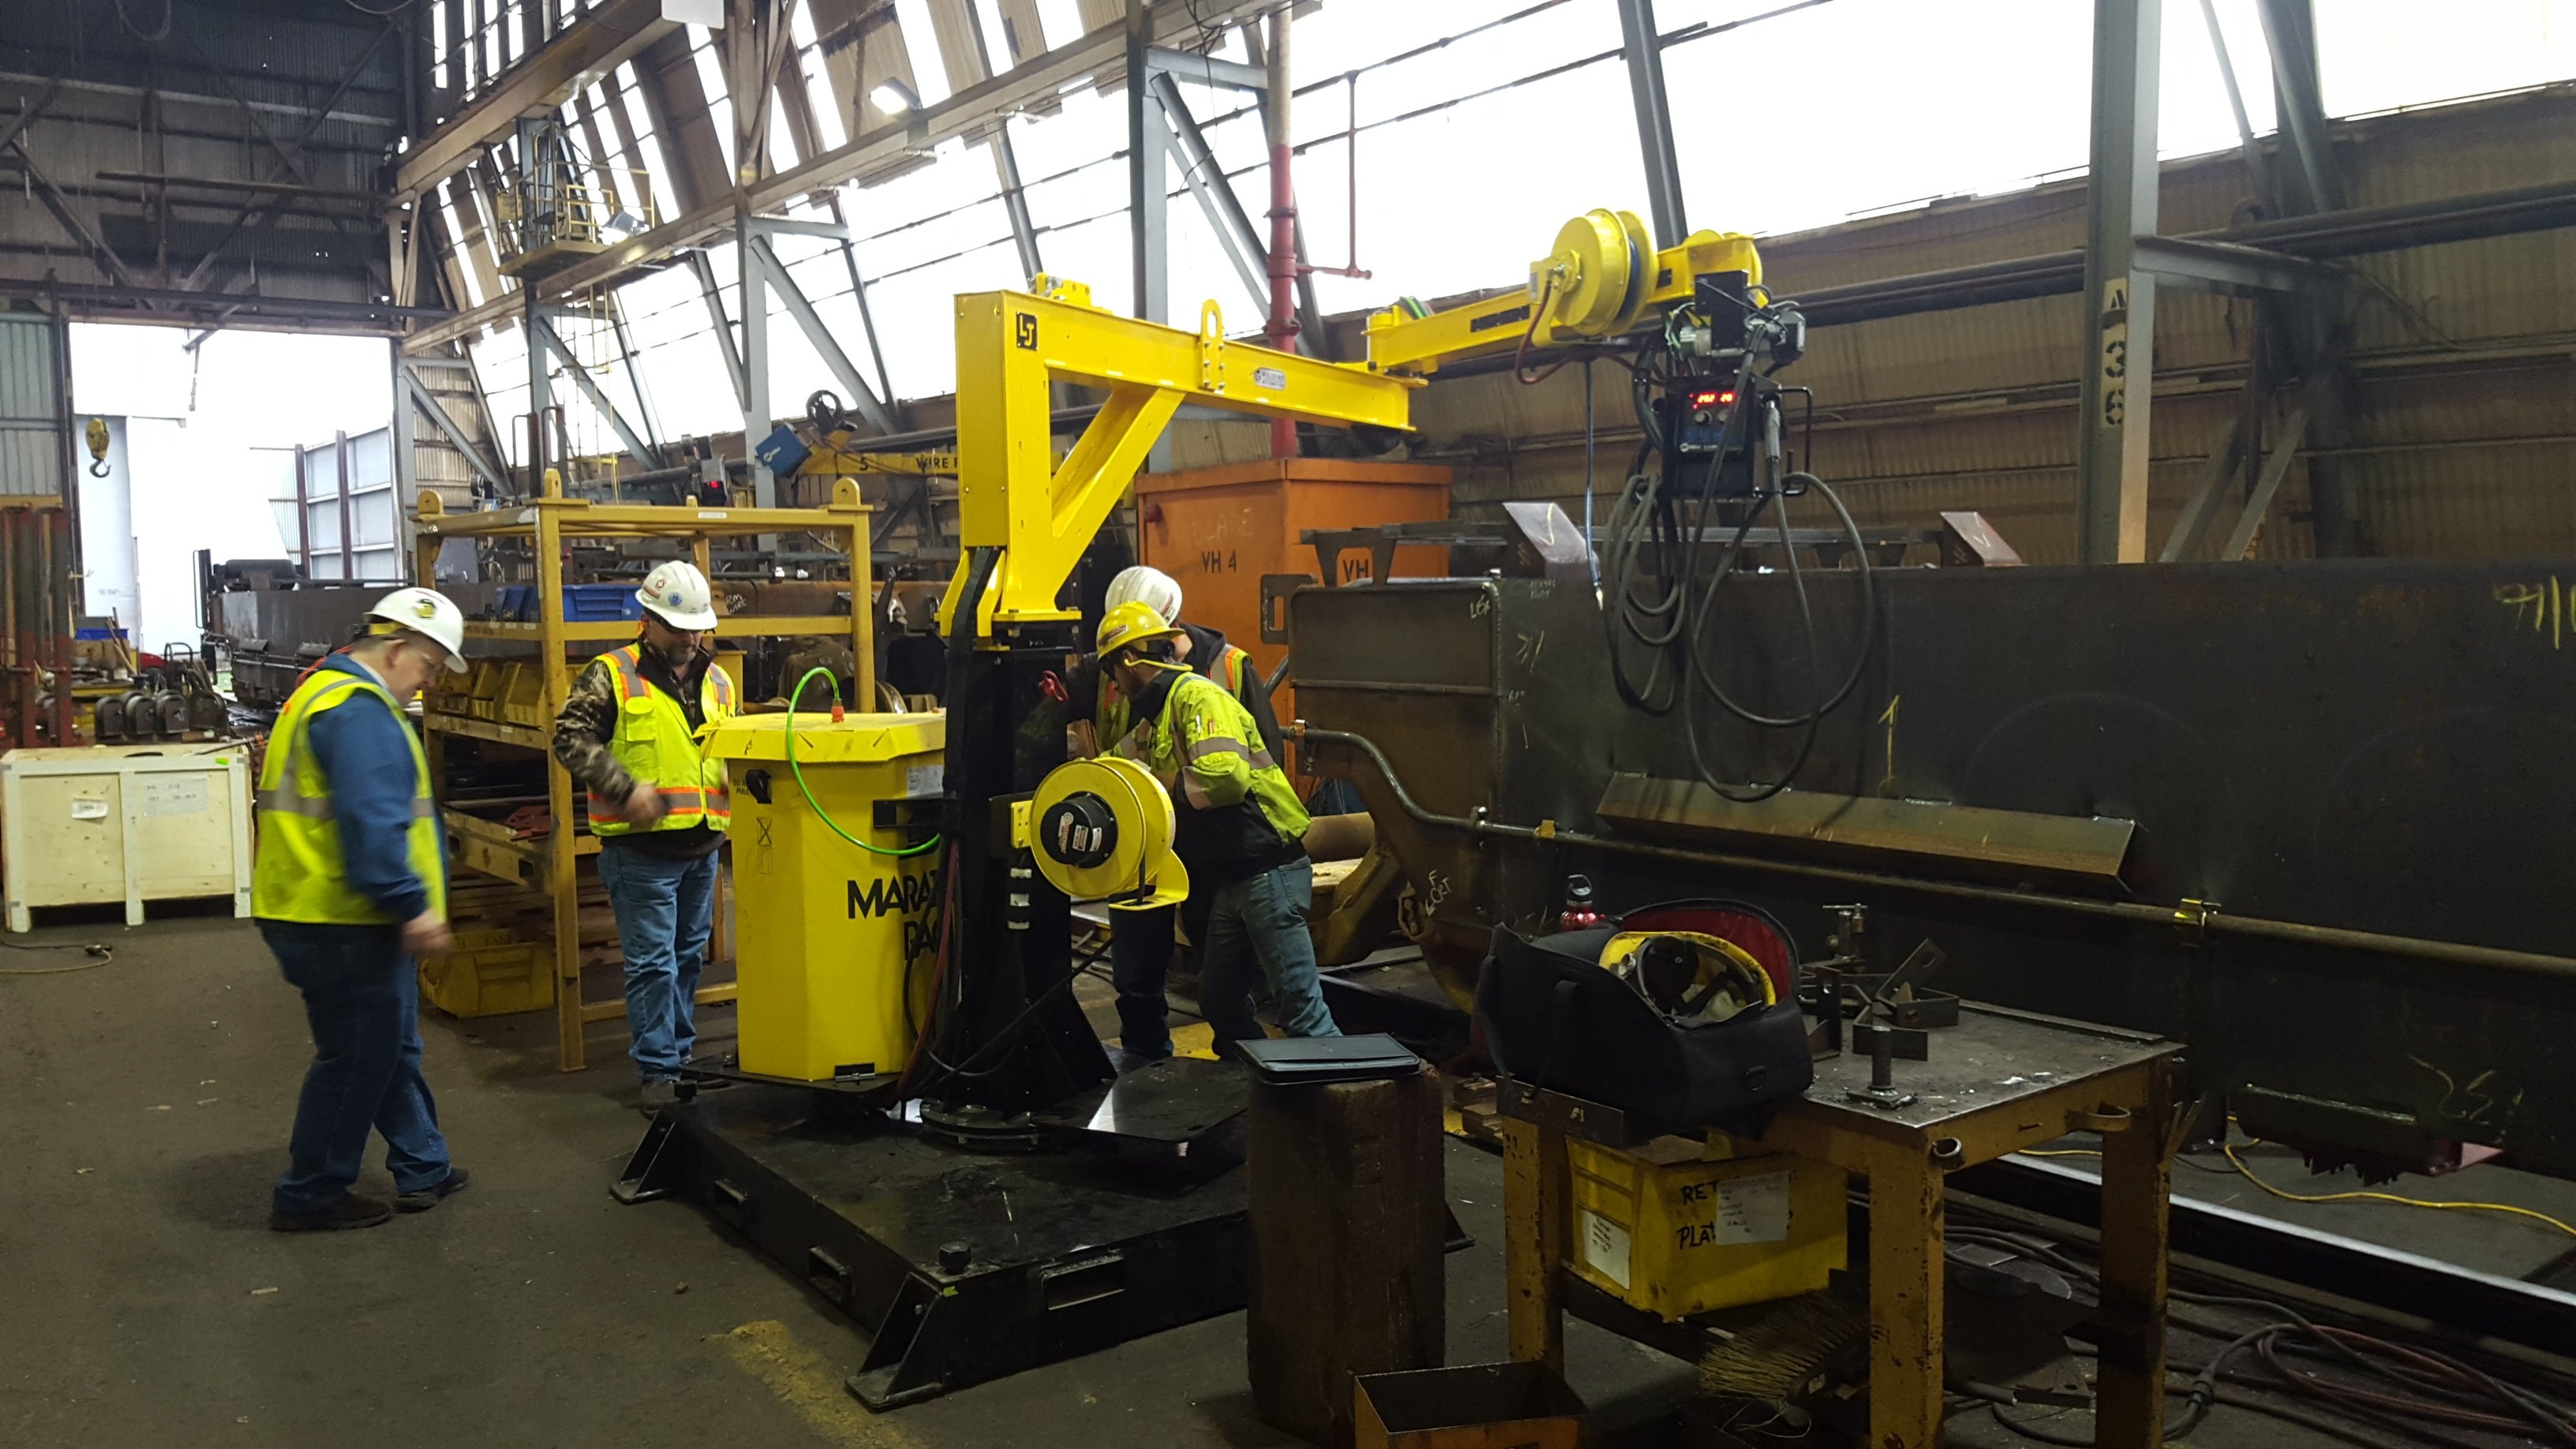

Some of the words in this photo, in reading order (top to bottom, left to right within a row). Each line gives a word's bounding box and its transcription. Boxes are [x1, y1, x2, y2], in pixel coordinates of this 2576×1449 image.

[1020, 314, 1035, 346] LJ
[1201, 551, 1222, 574] VH
[1228, 550, 1237, 573] 4
[1342, 559, 1369, 582] VH
